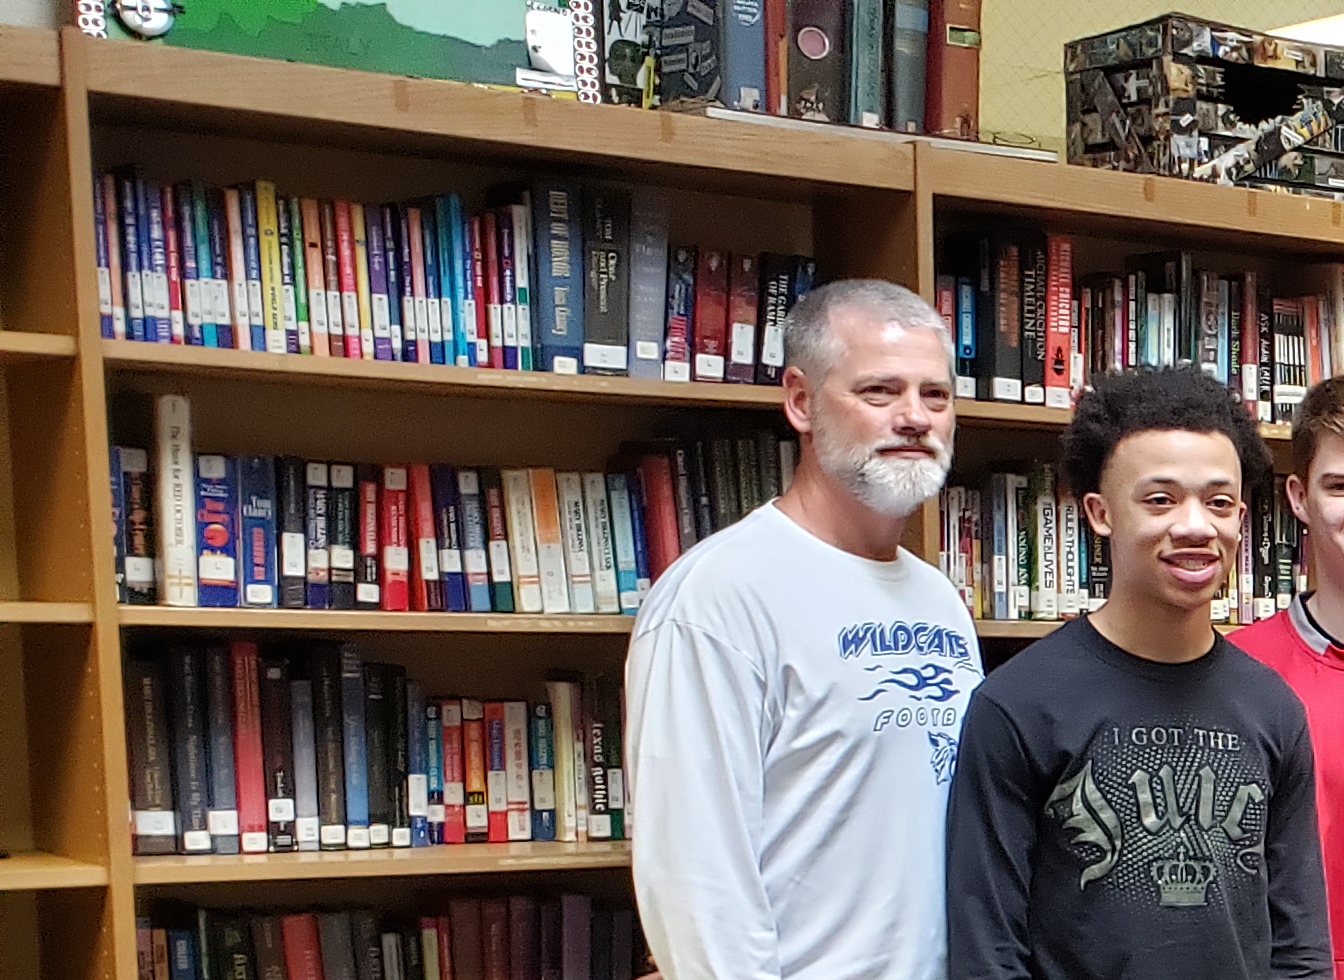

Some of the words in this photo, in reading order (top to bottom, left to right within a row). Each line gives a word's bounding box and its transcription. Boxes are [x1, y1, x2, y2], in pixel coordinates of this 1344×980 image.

[551, 223, 569, 237] OF
[551, 240, 571, 277] HONOR
[768, 281, 778, 294] OF
[779, 275, 789, 294] THE
[1024, 268, 1036, 340] TIMELINE
[1058, 287, 1070, 333] CRICHTON
[1036, 301, 1047, 360] CRICHTON
[1231, 311, 1240, 341] Dark
[1260, 313, 1270, 333] ASK
[1231, 342, 1241, 375] Shade
[1261, 338, 1271, 364] AGAIN
[170, 426, 180, 441] The
[171, 444, 182, 465] Hunt
[172, 468, 182, 480] for
[172, 484, 183, 502] RED
[251, 495, 272, 507] Tom
[316, 489, 327, 514] MARY
[365, 483, 377, 501] MARY
[173, 503, 185, 546] OCTOBER
[365, 502, 377, 530] HIGGINS
[1043, 507, 1054, 546] GAME
[1065, 505, 1076, 533] RULE
[316, 515, 327, 548] HIGGINS
[365, 531, 377, 553] CLARK
[1017, 529, 1028, 565] YOUNG
[1044, 552, 1055, 588] LIVES
[1065, 539, 1076, 594] THOUGHTS
[838, 620, 972, 661] WILDCATS
[873, 706, 957, 732] FOOTB
[1112, 727, 1121, 745] I
[1131, 727, 1184, 746] GOT
[1194, 727, 1241, 751] THE
